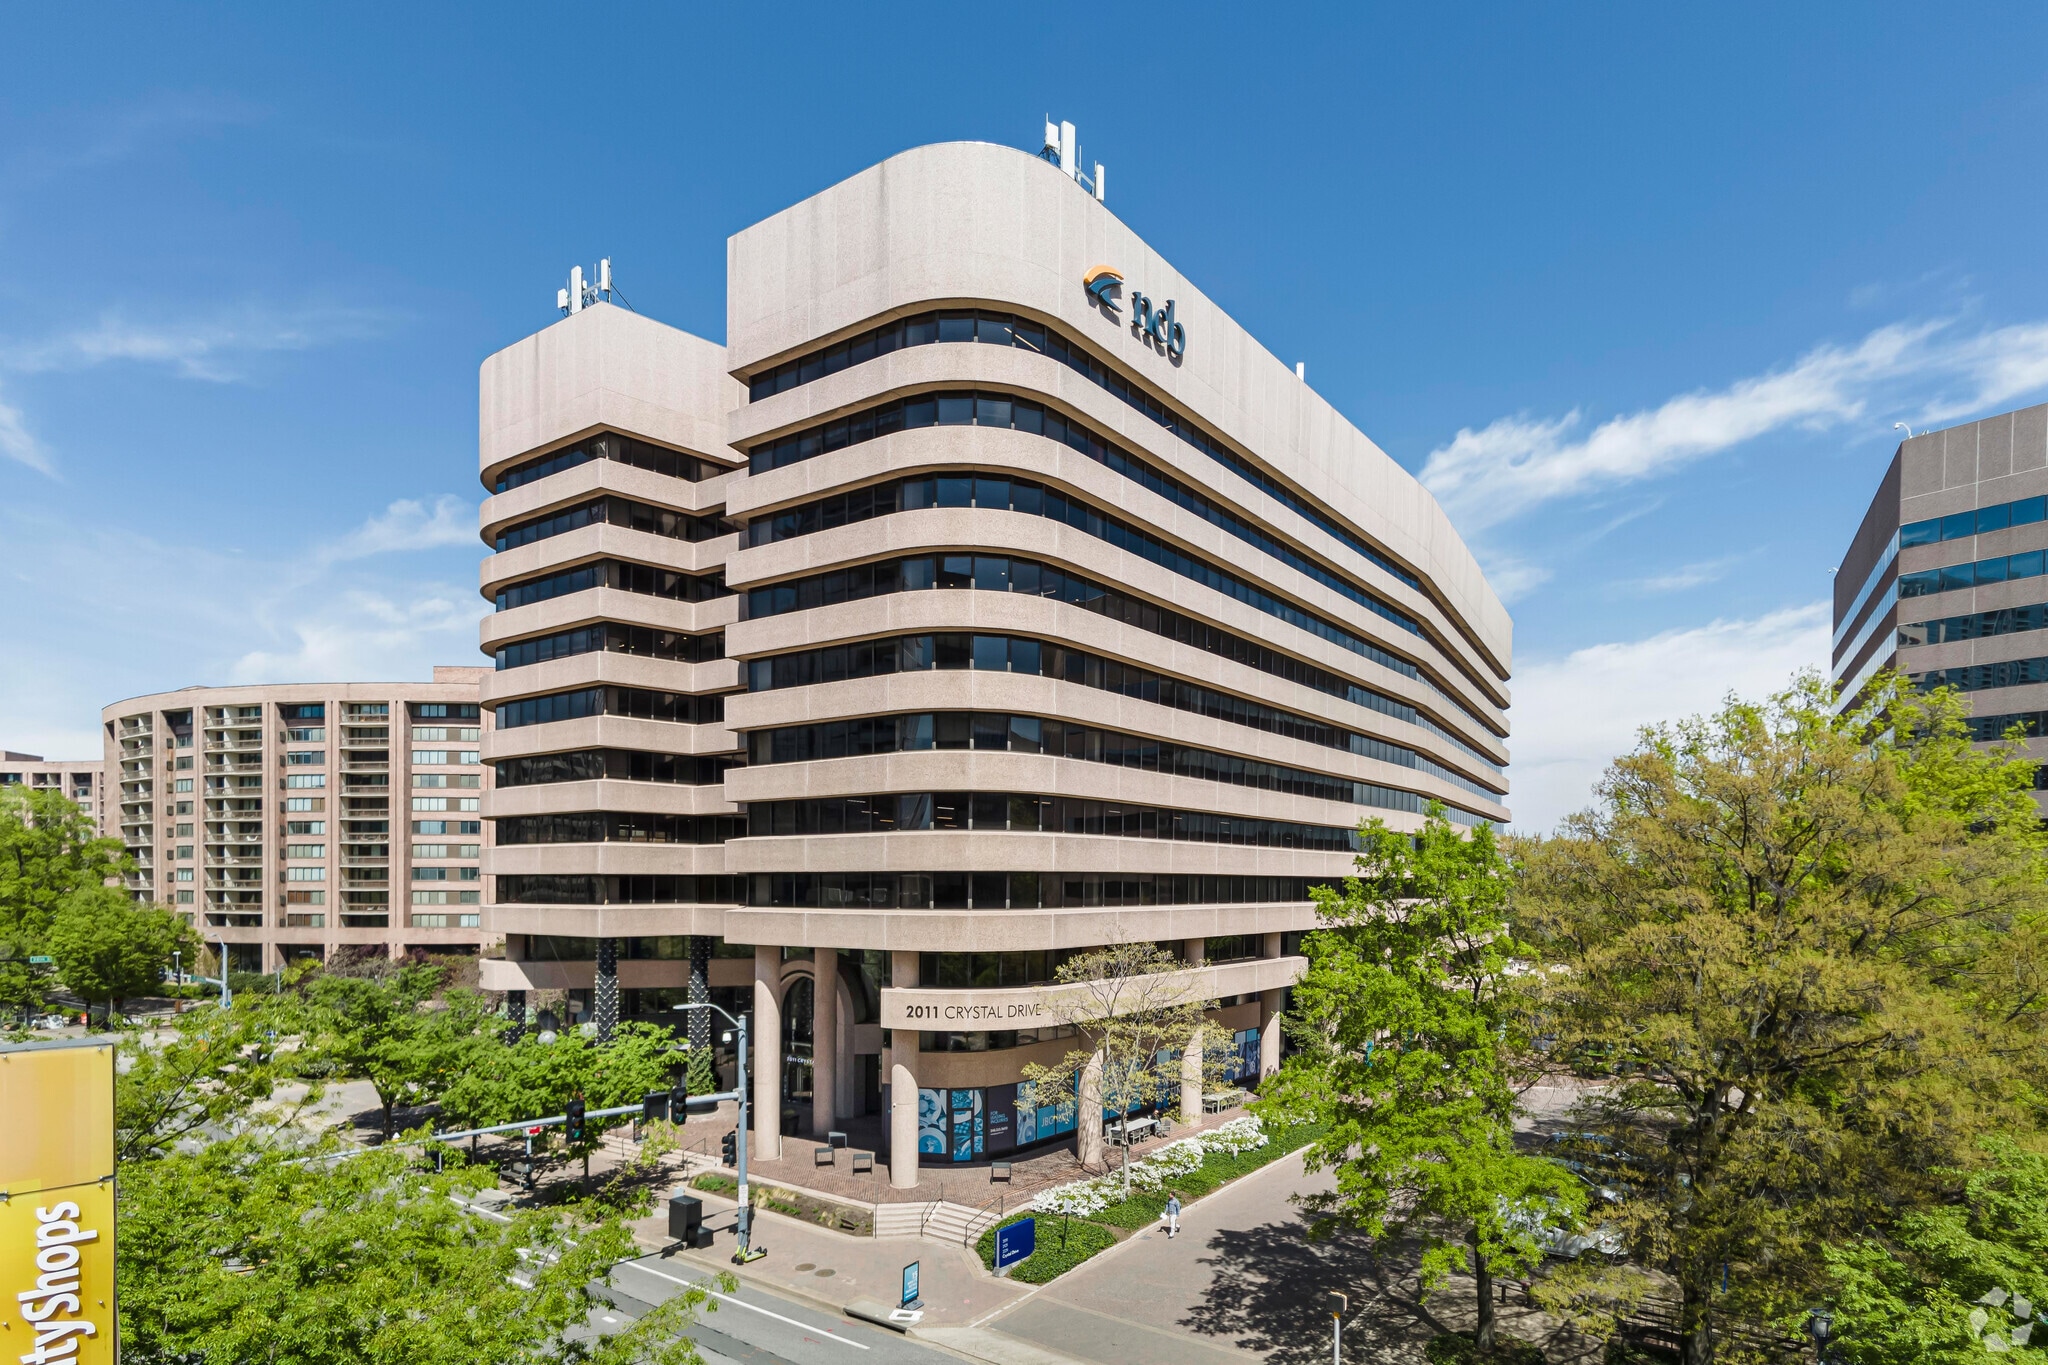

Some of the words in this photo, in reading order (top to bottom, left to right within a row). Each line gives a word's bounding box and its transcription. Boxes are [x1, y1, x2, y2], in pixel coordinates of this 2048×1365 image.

[1131, 291, 1186, 355] ncb
[906, 1005, 938, 1019] 2011
[944, 1005, 1003, 1019] CRYSTAL
[1007, 1003, 1042, 1018] DRIVE
